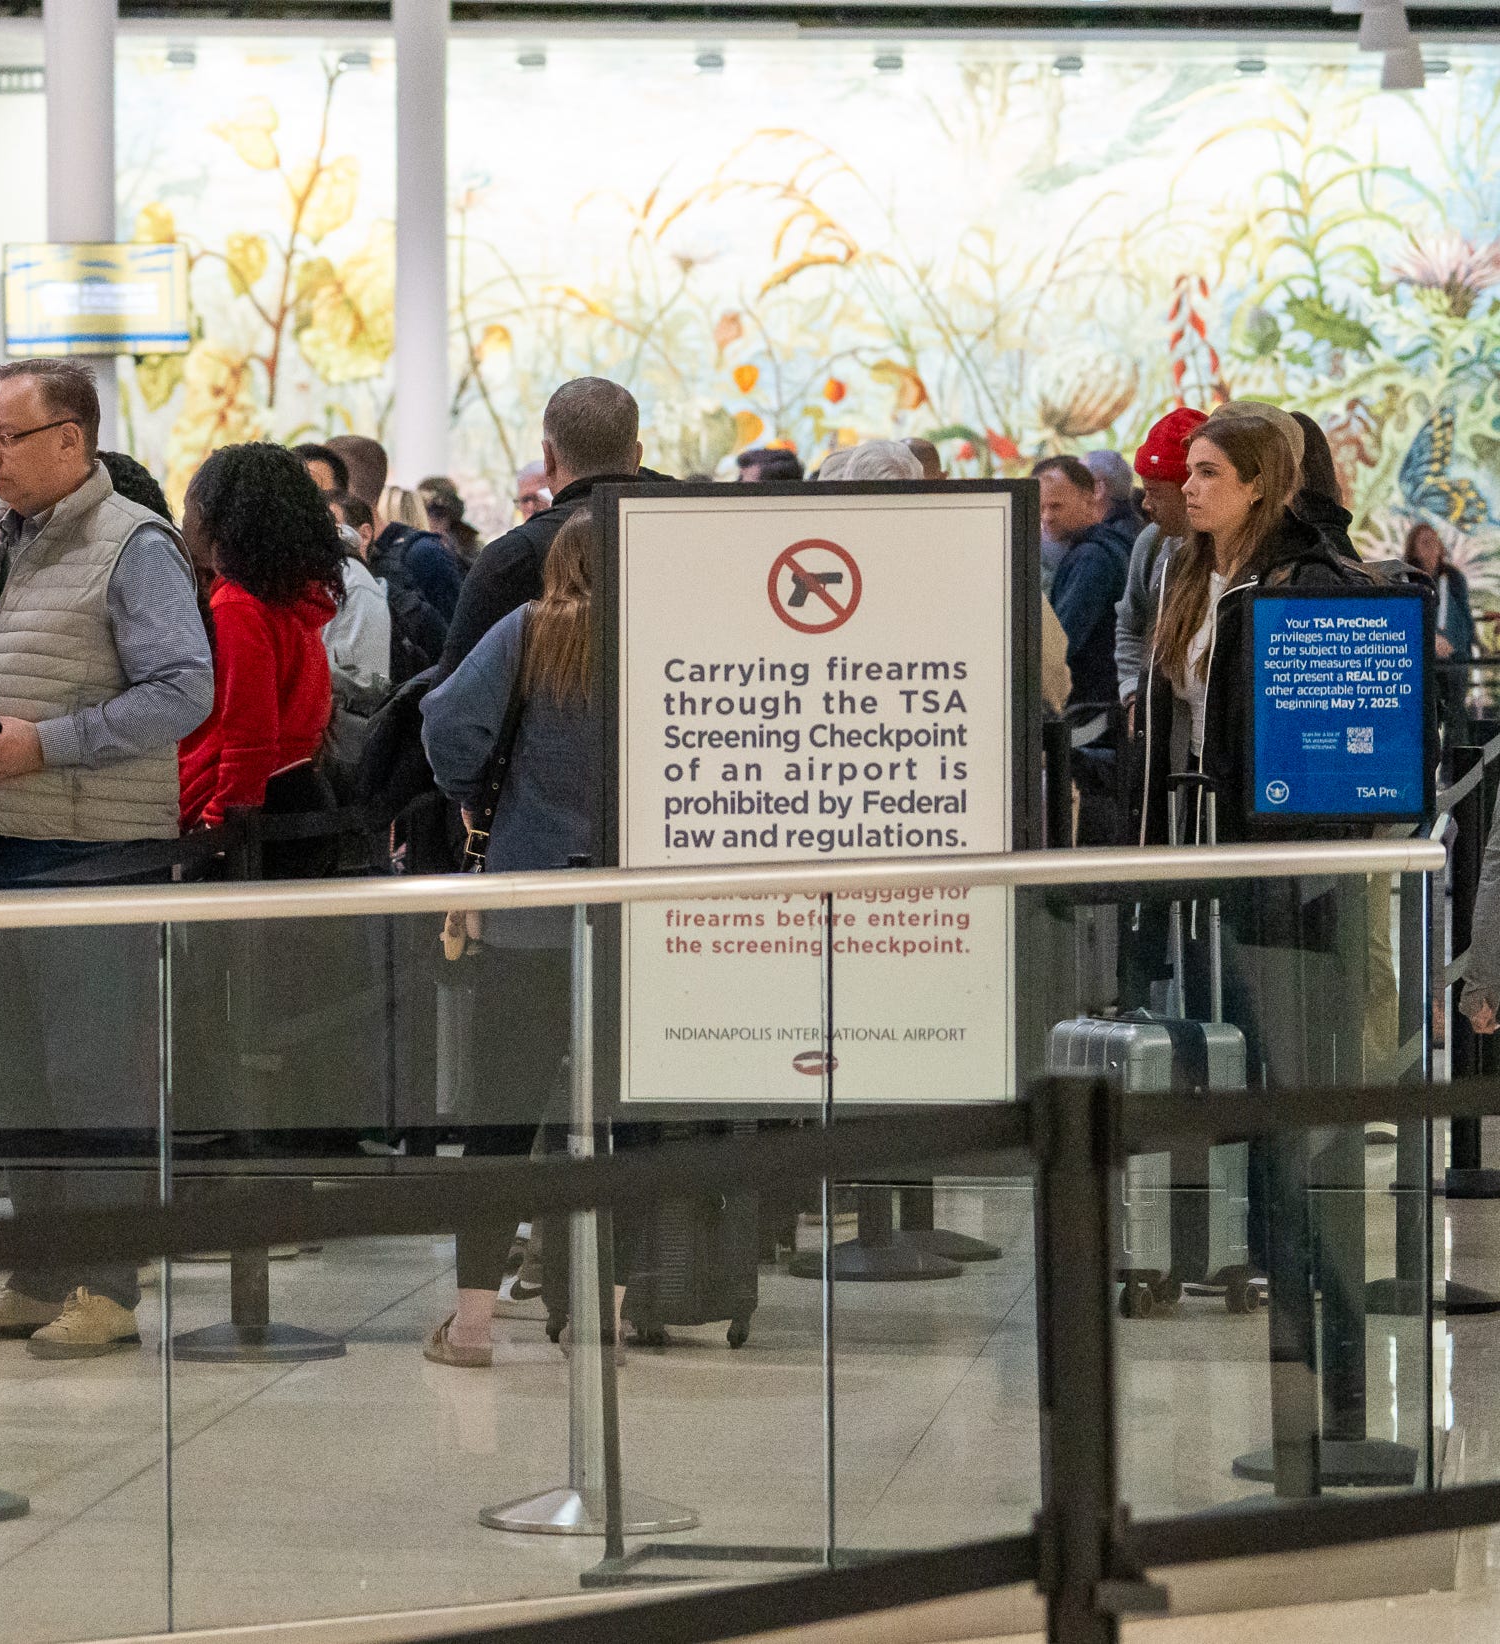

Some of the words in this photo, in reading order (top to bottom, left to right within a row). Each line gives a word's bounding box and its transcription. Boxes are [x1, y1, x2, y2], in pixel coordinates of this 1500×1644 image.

[1285, 618, 1311, 629] Your
[1313, 618, 1335, 628] TSA
[1337, 617, 1388, 628] PreCheck
[1270, 632, 1323, 643] privileges
[1325, 634, 1350, 644] may
[1352, 631, 1365, 642] be
[1369, 631, 1406, 641] denied
[1268, 646, 1280, 656] or
[1283, 645, 1296, 656] be
[1299, 644, 1337, 657] subject
[1340, 645, 1351, 655] to
[1354, 643, 1408, 655] additional
[664, 657, 810, 686] Carrying
[826, 656, 968, 680] firearms
[1264, 658, 1307, 670] security
[1310, 659, 1362, 669] measures
[1364, 657, 1373, 668] if
[1375, 658, 1395, 670] you
[1398, 657, 1413, 668] do
[1273, 672, 1291, 682] not
[1293, 672, 1334, 684] present
[1337, 673, 1343, 682] a
[1346, 671, 1375, 682] REAL
[1378, 671, 1390, 681] ID
[1391, 671, 1403, 681] or
[1265, 685, 1294, 696] other
[1297, 685, 1353, 696] acceptable
[1356, 684, 1383, 695] form
[1385, 683, 1397, 695] of
[1400, 684, 1412, 695] ID
[663, 690, 802, 719] through
[822, 690, 878, 715] the
[899, 689, 968, 714] TSA
[1275, 699, 1329, 710] beginning
[1331, 698, 1355, 710] May
[1357, 698, 1368, 710] 7,
[1370, 698, 1401, 709] 2025.
[664, 724, 801, 752] Screening
[809, 722, 968, 752] Checkpoint
[664, 757, 701, 782] of
[721, 759, 762, 782] an
[784, 756, 919, 785] airport
[939, 755, 968, 780] is
[1356, 786, 1377, 798] TSA
[1379, 786, 1398, 798] Pre
[664, 791, 809, 819] prohibited
[818, 790, 852, 819] by
[863, 789, 967, 815] Federal
[664, 823, 715, 848] law
[722, 823, 778, 848] and
[785, 822, 968, 852] regulations.
[665, 910, 765, 927] firearms
[777, 910, 856, 927] before
[868, 910, 971, 930] entering
[665, 936, 702, 954] the
[712, 936, 823, 957] screening
[832, 936, 971, 957] checkpoint.
[664, 1026, 773, 1041] INDIANAPOLIS
[903, 1026, 967, 1041] AIRPORT
